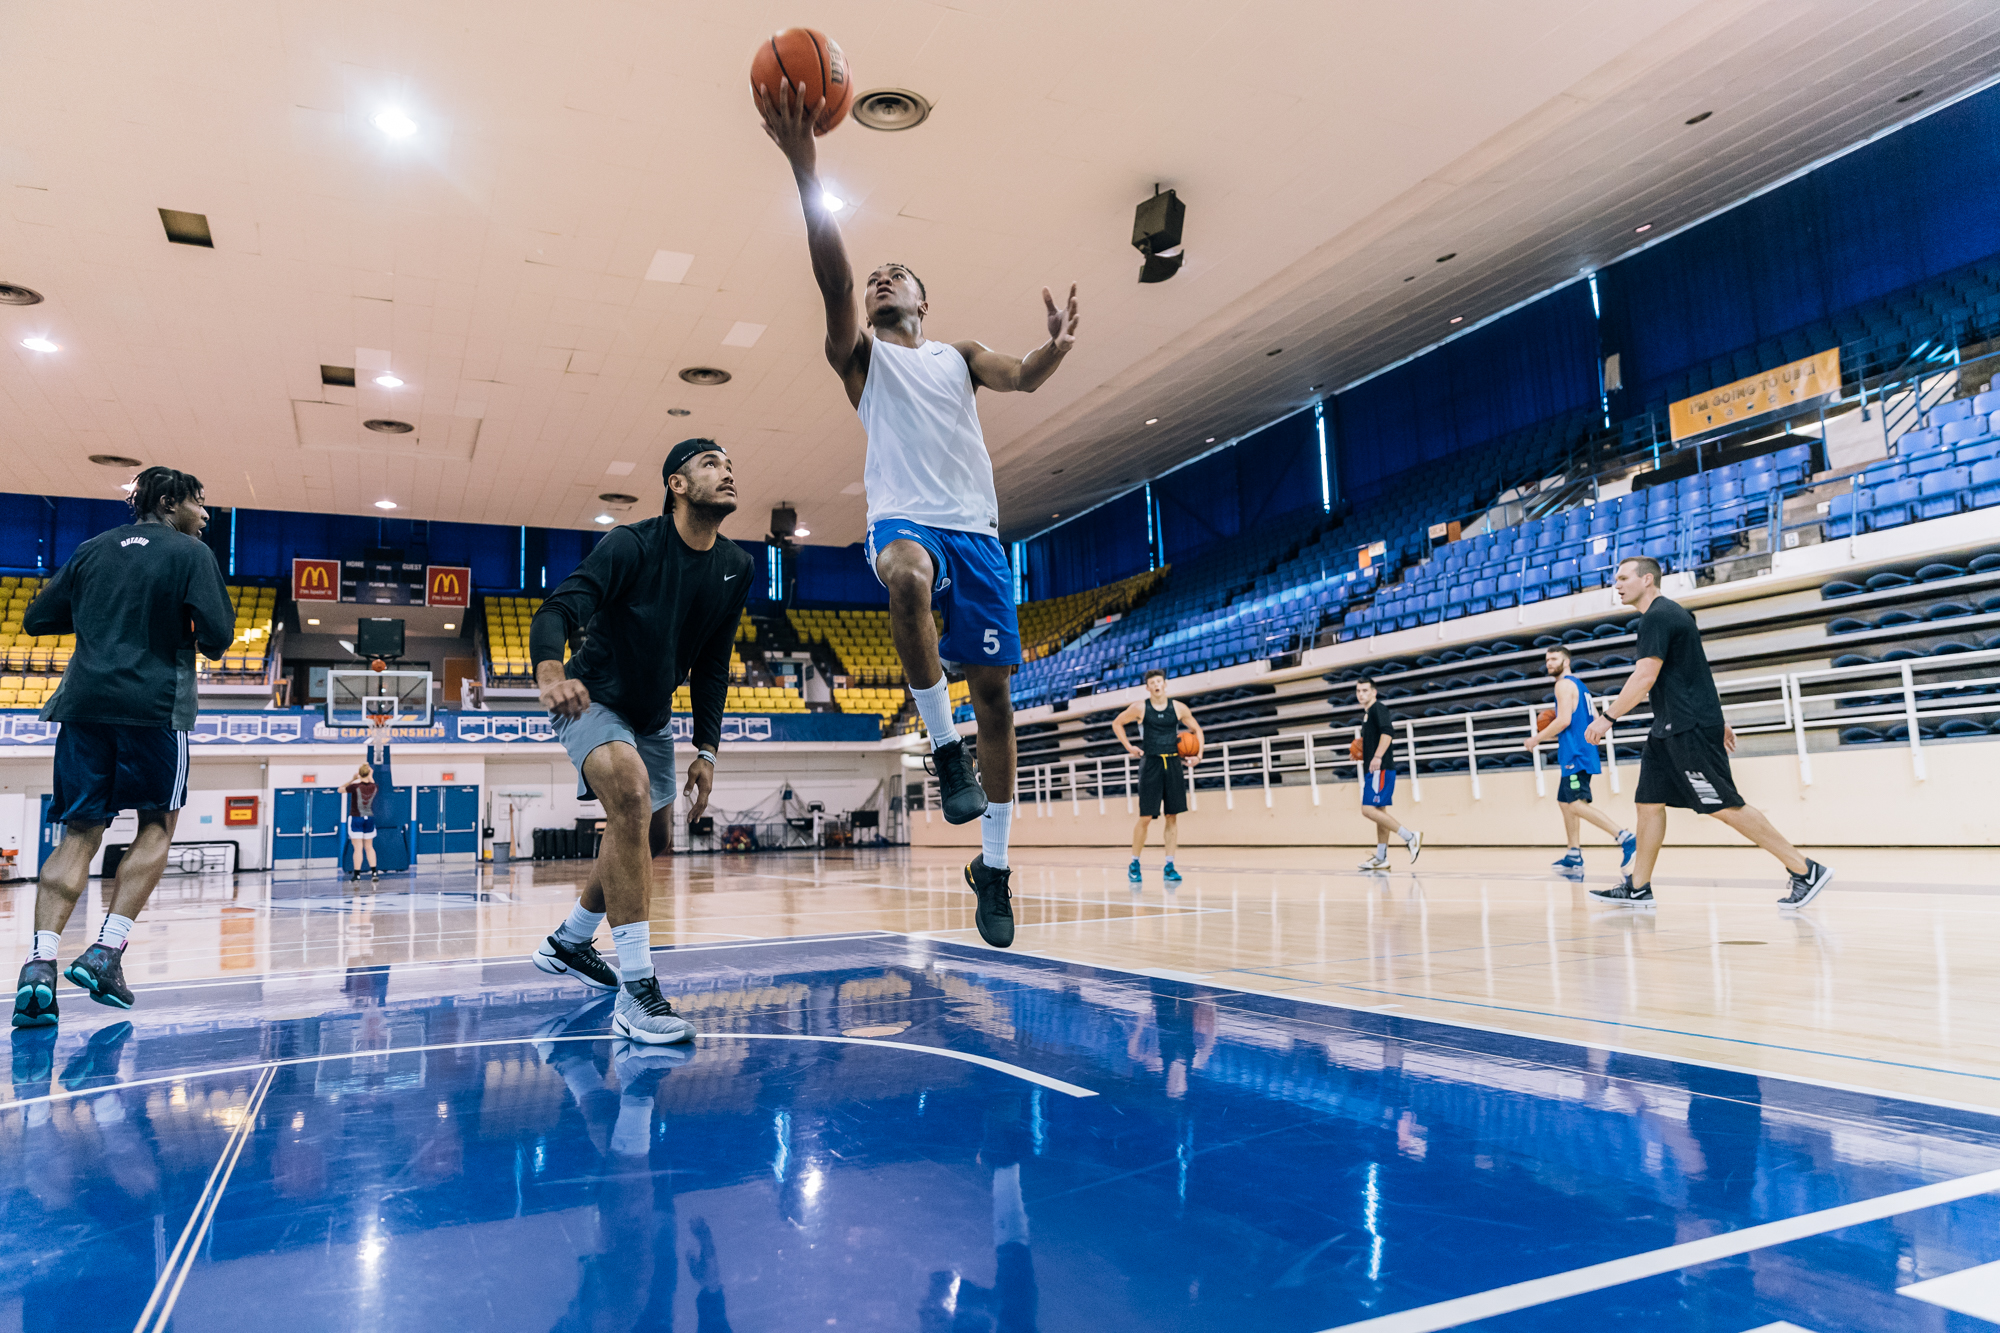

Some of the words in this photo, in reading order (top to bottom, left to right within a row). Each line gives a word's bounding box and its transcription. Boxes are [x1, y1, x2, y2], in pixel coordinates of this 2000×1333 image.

[1713, 385, 1756, 407] GOING
[1761, 375, 1778, 391] TO
[120, 536, 150, 548] ONTARIO
[402, 563, 422, 571] GUEST
[982, 628, 1001, 655] 5
[313, 727, 338, 738] UBC
[1684, 770, 1723, 804] NIKE
